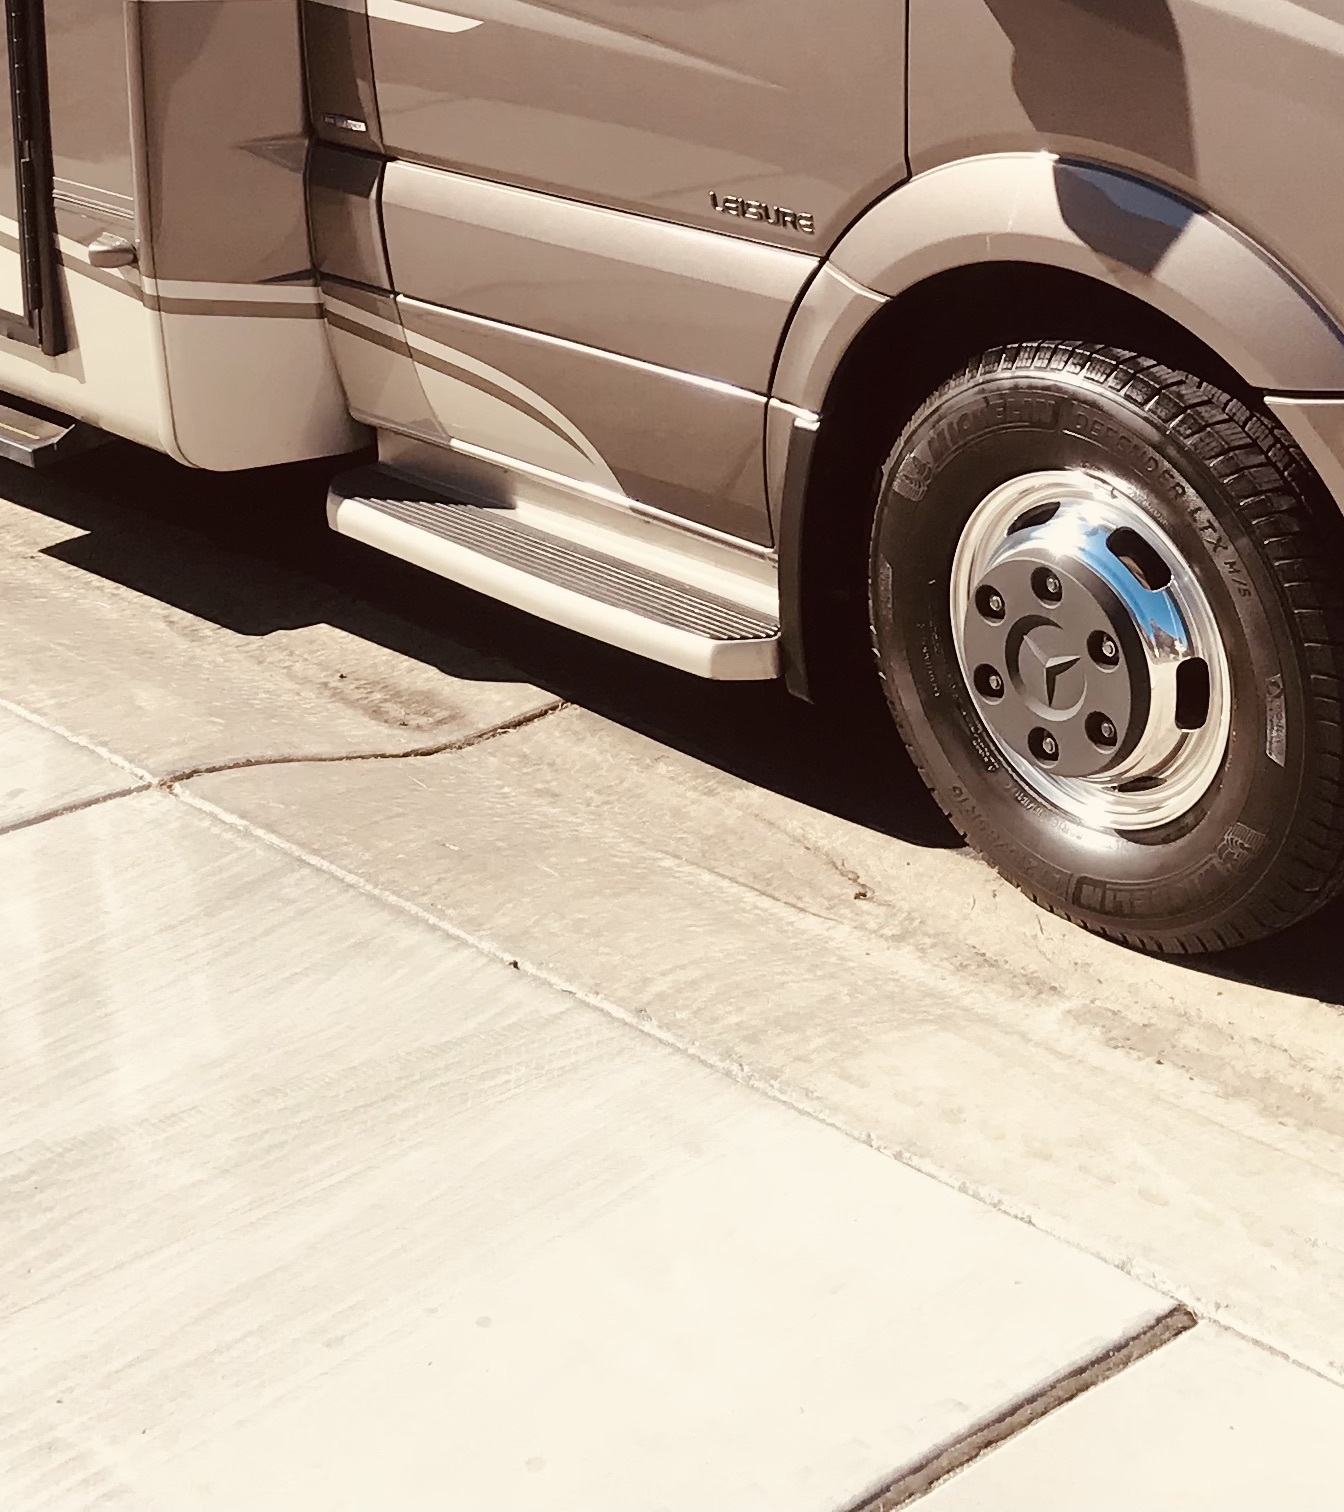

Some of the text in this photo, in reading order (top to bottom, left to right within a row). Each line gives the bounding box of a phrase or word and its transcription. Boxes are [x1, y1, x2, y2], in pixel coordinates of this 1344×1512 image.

[709, 191, 815, 235] LEISURE
[1075, 410, 1188, 503] DEFENDER
[1187, 506, 1229, 554] LTX
[1224, 560, 1252, 599] M/S
